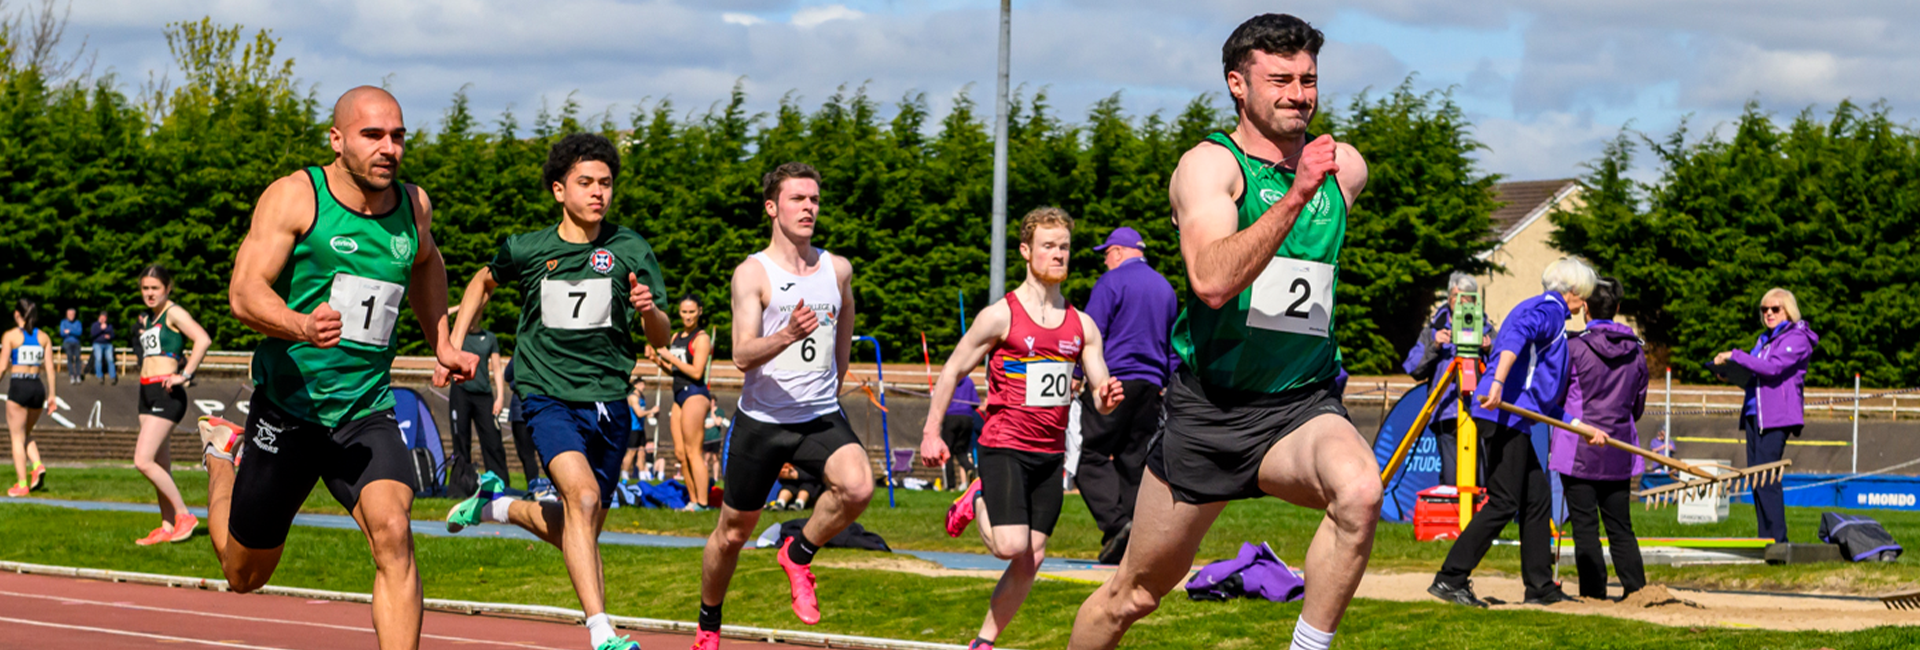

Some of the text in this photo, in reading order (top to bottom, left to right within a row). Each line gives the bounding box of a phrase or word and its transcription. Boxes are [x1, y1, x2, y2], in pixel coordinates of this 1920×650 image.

[568, 291, 587, 318] 7
[808, 303, 831, 311] OLLEGE
[1285, 278, 1311, 319] 2
[361, 295, 376, 330] 1
[801, 337, 816, 363] 6
[1041, 373, 1067, 397] 20
[1868, 492, 1916, 507] MONDO
